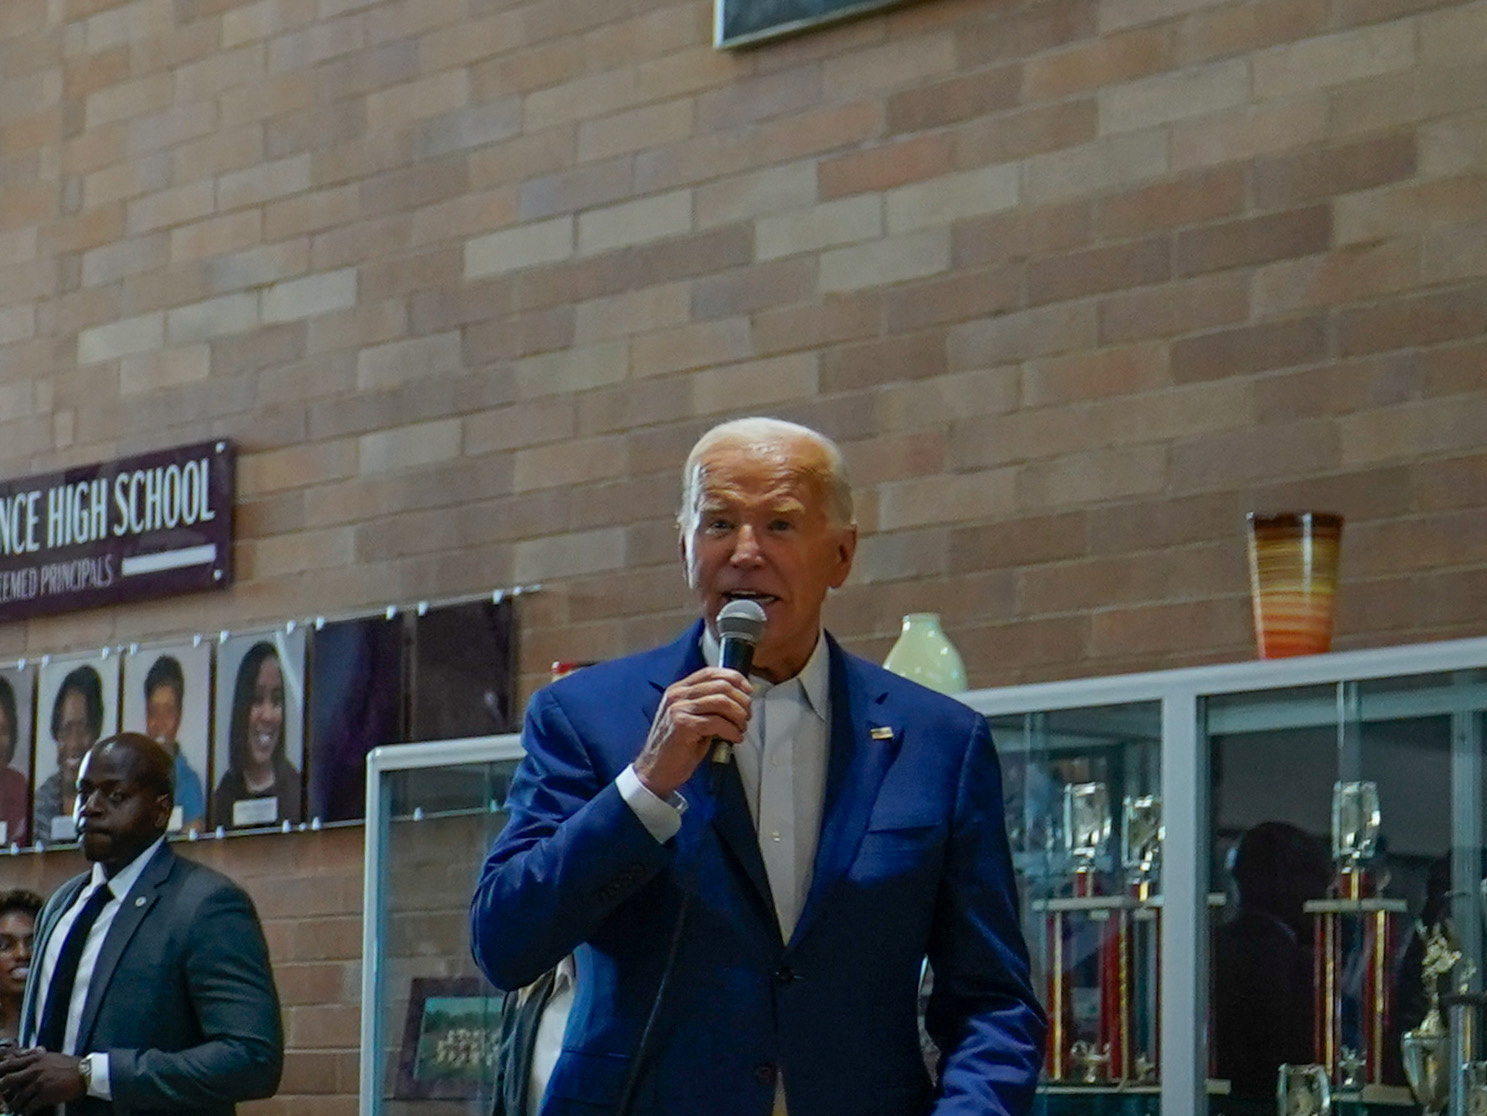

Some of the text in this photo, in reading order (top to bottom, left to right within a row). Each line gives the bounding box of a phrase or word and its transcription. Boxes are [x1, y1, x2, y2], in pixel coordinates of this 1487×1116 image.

[47, 477, 109, 548] HIGH
[112, 457, 216, 537] SCHOOL
[40, 553, 113, 596] PRINCIPALS
